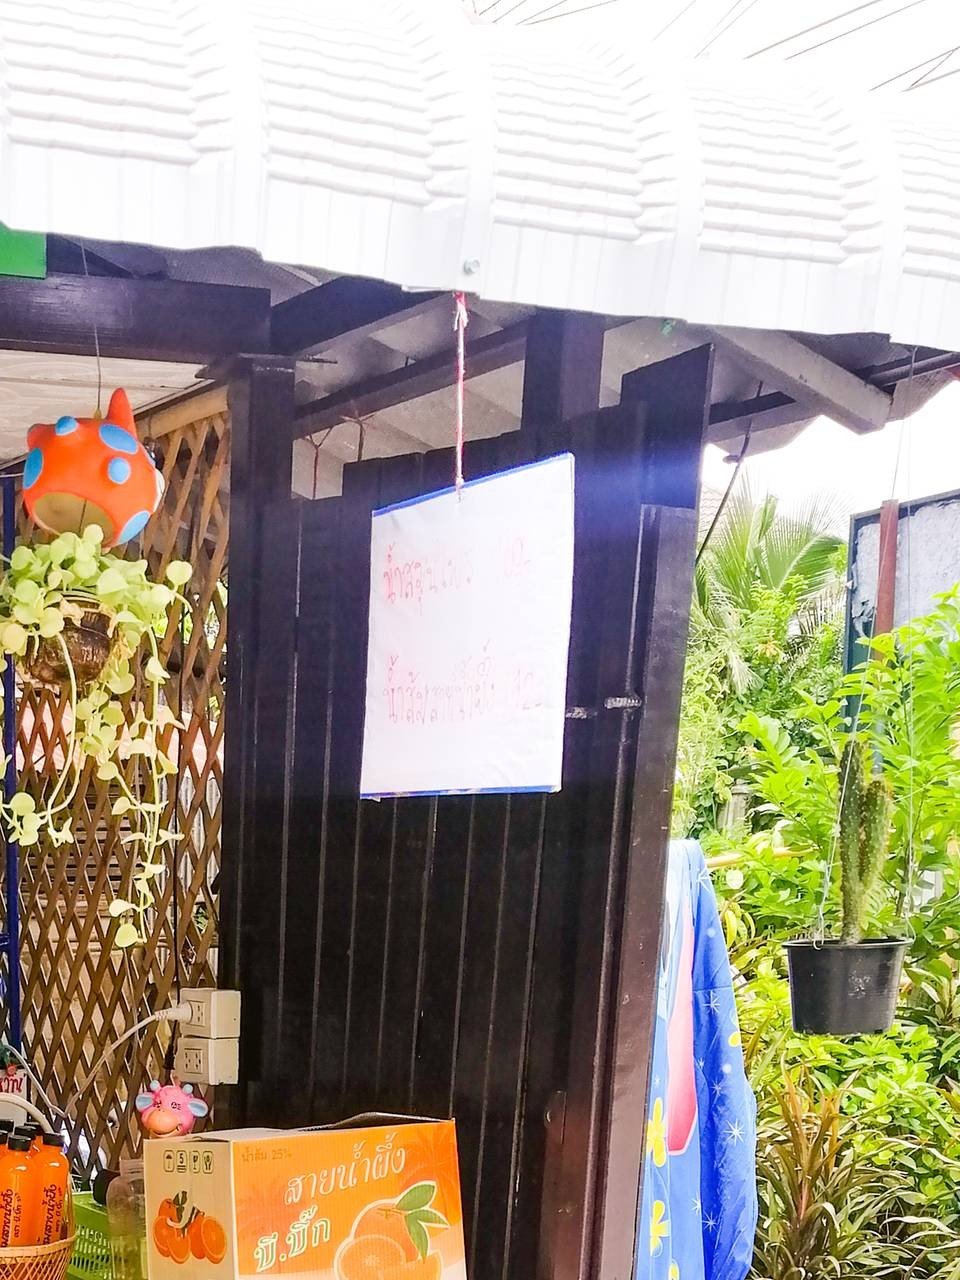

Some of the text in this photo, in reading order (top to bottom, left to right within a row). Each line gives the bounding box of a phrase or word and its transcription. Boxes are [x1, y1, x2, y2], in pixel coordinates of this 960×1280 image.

[284, 1133, 405, 1205] สายน้ำผึ้ง
[254, 1205, 330, 1272] บี.บิ๊ก
